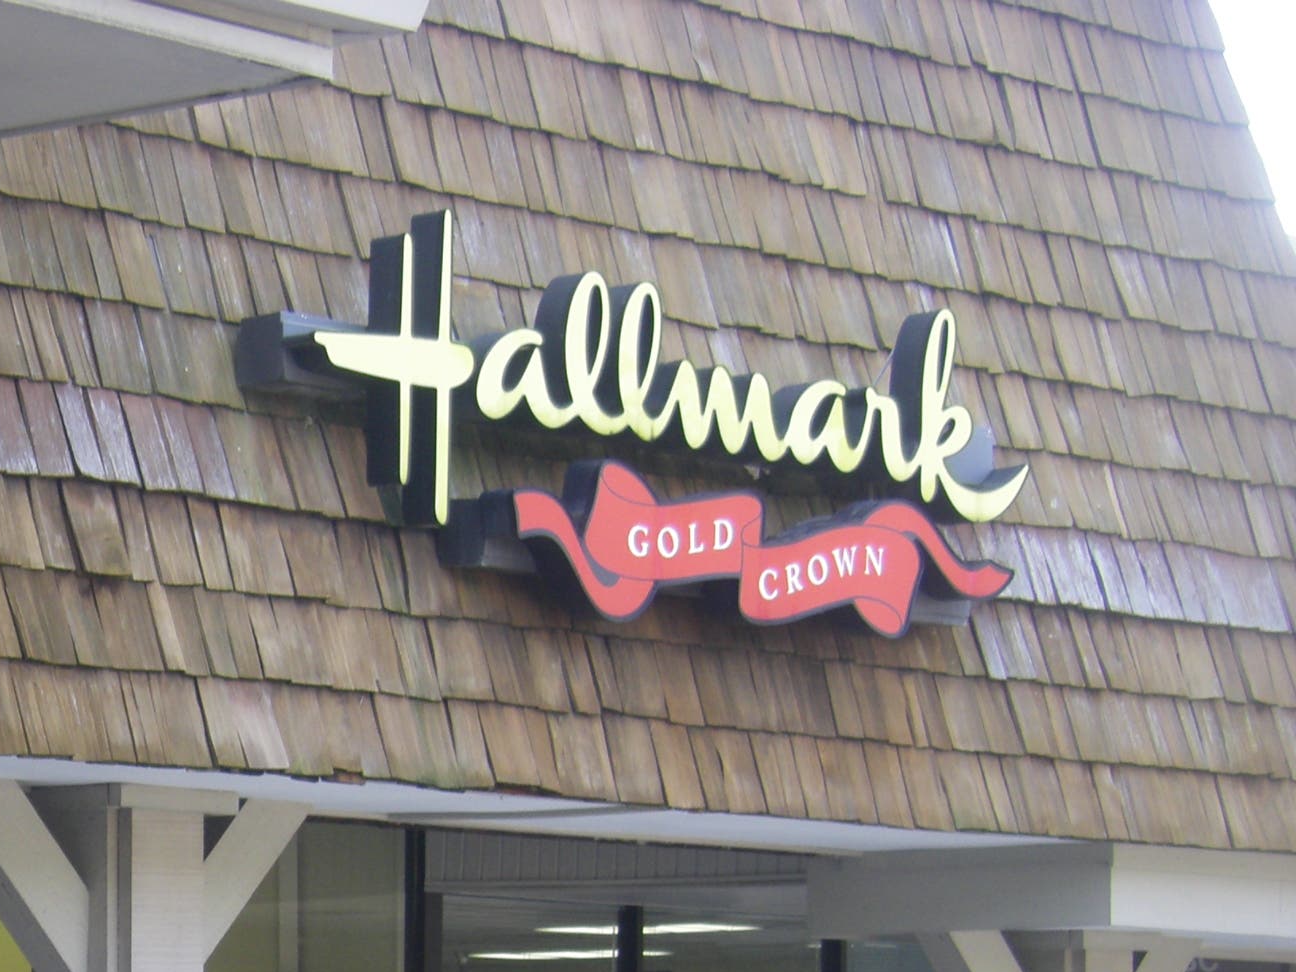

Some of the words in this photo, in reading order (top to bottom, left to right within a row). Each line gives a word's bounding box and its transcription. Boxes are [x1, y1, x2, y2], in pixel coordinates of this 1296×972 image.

[315, 209, 1029, 526] Hallmark
[627, 516, 734, 559] GOLD
[758, 544, 886, 601] CROWN
